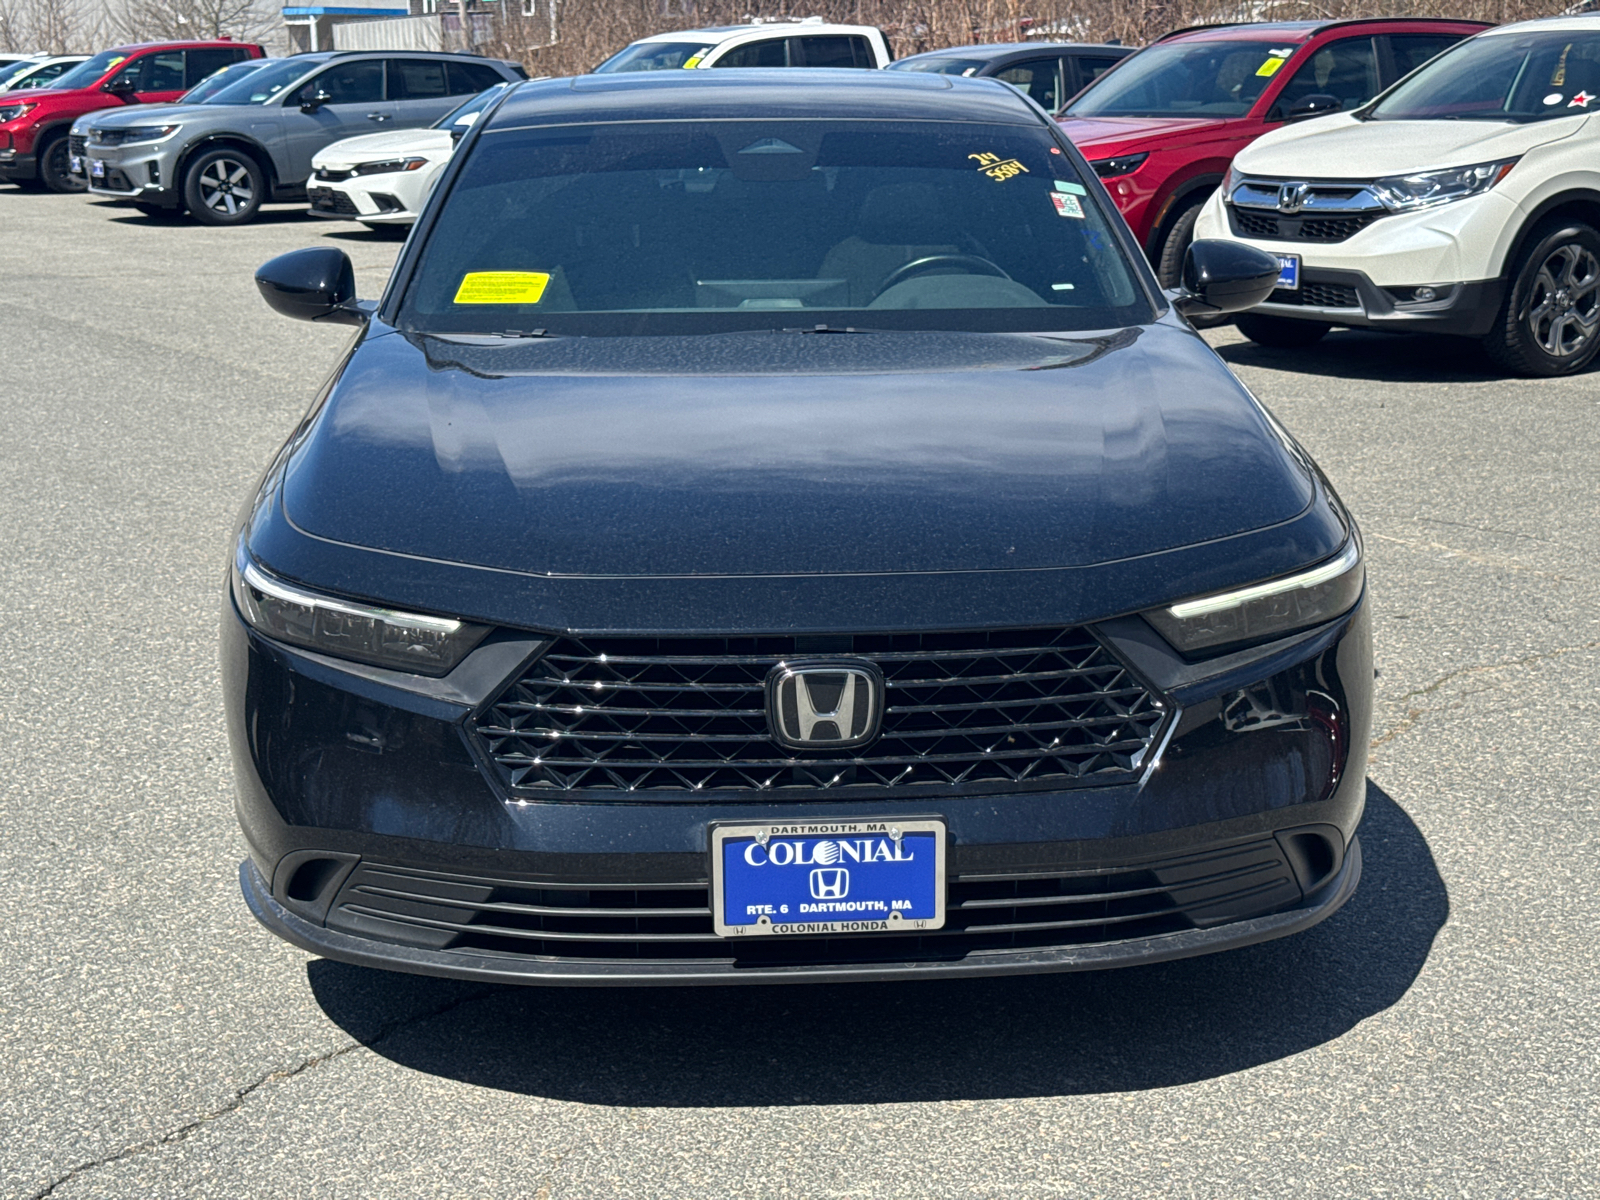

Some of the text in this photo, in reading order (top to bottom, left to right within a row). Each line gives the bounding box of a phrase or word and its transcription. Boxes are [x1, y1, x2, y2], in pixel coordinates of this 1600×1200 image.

[771, 823, 887, 834] DARTMOUTH, MA
[744, 839, 914, 866] COLONIAL
[746, 900, 913, 915] RTE. 6 DARTMOUTH, MA
[772, 921, 888, 934] COLONIAL HONDA
